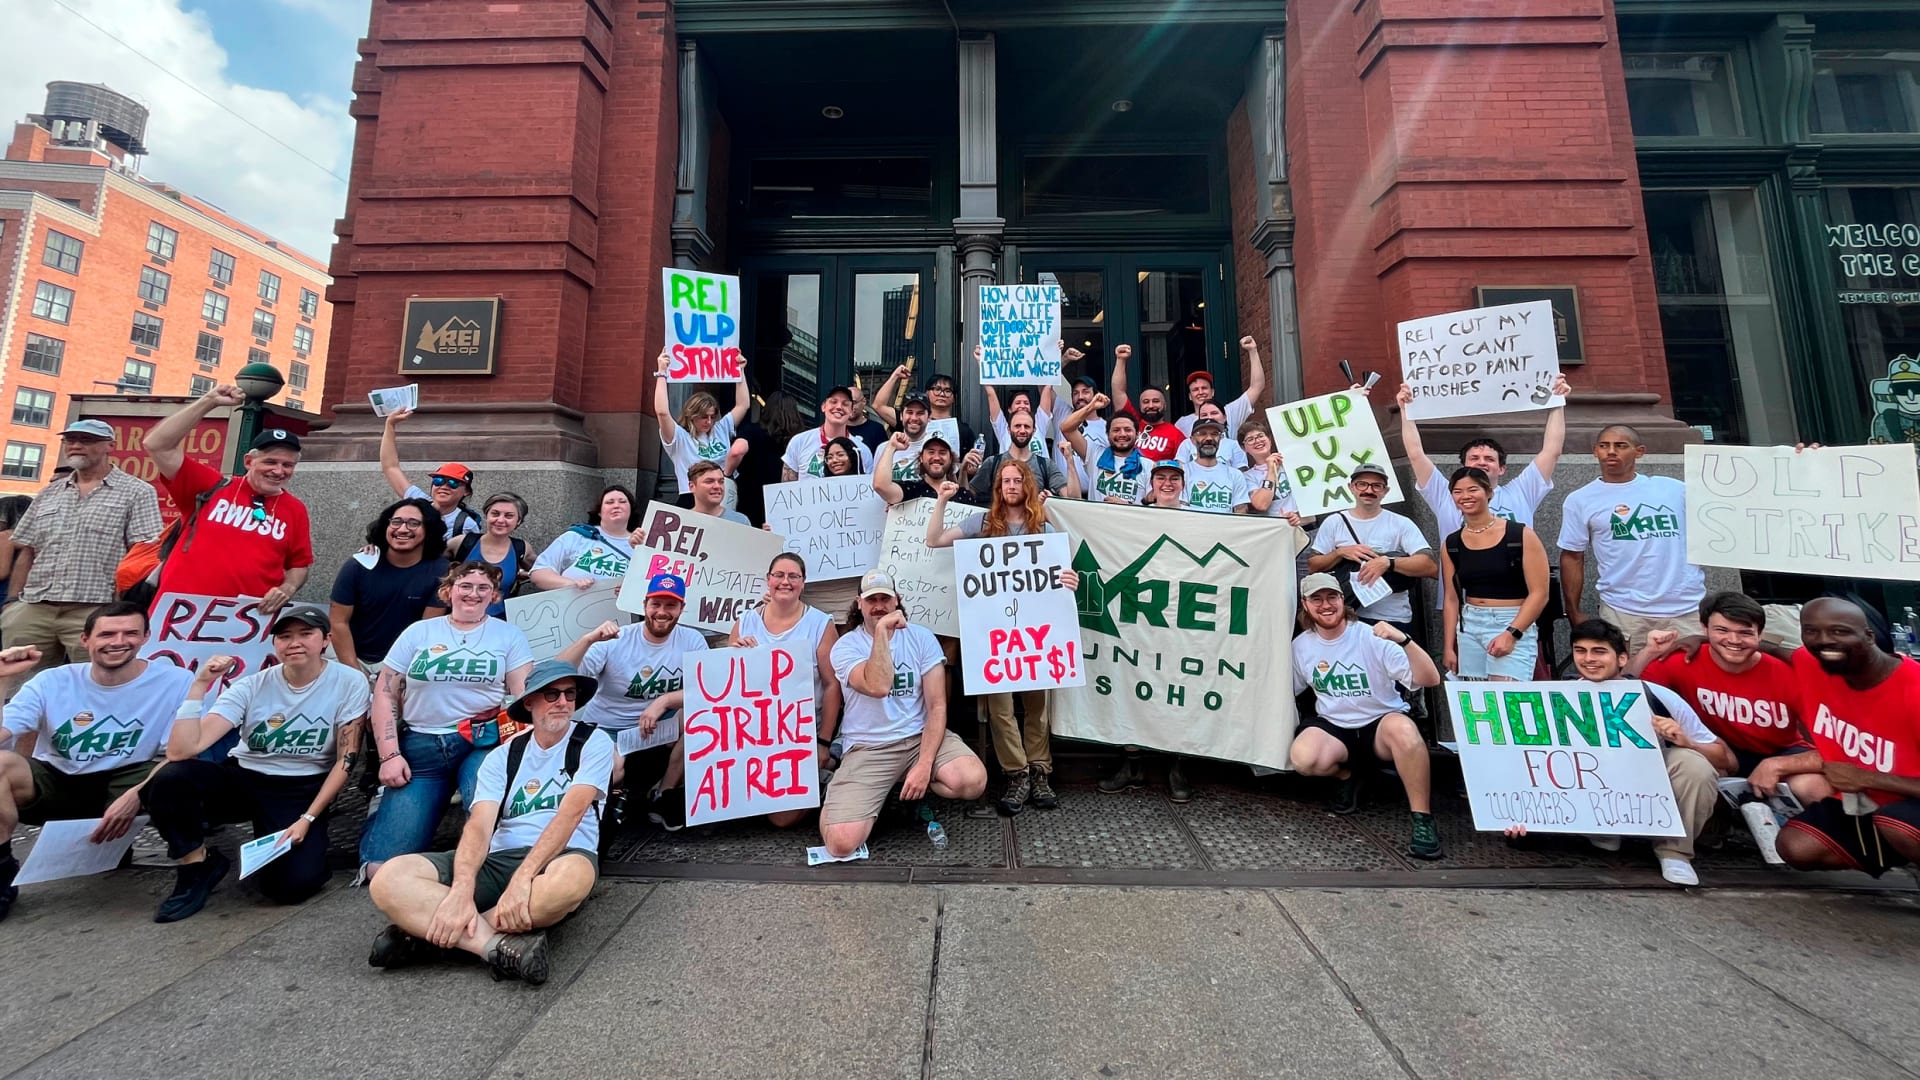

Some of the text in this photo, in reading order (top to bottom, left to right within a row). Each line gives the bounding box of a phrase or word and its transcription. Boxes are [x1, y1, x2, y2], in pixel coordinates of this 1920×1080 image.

[1825, 223, 1920, 247] WELCO
[1839, 253, 1920, 277] THE C
[671, 274, 727, 313] REI
[981, 287, 1009, 303] HOW
[981, 302, 1054, 320] HAVE A LIFE
[438, 329, 481, 347] REI
[674, 312, 735, 346] ULP
[1038, 320, 1052, 335] IF
[1406, 311, 1531, 345] REI CUT MY
[670, 344, 741, 381] STRIKE
[1034, 346, 1044, 360] A
[1408, 334, 1521, 367] PAY CANT
[981, 360, 1025, 379] LIVING
[1406, 355, 1535, 381] AFFORD PAINT
[1412, 379, 1481, 399] BRUSHES
[1282, 394, 1352, 439] ULP
[1312, 435, 1339, 461] U
[1295, 449, 1373, 487] PAY
[1701, 454, 1885, 498] ULP
[769, 482, 876, 515] AN INJURY
[1113, 479, 1138, 496] REI
[1206, 488, 1232, 503] REI
[1322, 486, 1354, 508] M
[207, 498, 287, 541] RWDSU
[783, 506, 860, 535] TO ONE
[1637, 514, 1679, 531] REI
[1696, 501, 1920, 564] STRIKE
[645, 509, 709, 562] REI,
[808, 533, 829, 555] AN
[836, 528, 883, 549] INJUR
[893, 530, 905, 542] I
[1638, 530, 1680, 541] UNION
[596, 560, 628, 574] RE
[818, 551, 868, 573] ALL
[979, 540, 1045, 568] OPT
[963, 565, 1063, 598] OUTSIDE
[699, 597, 764, 624] WAG
[1004, 598, 1018, 627] of
[1119, 577, 1249, 636] REI
[989, 624, 1051, 657] PAY
[435, 658, 498, 676] REI
[697, 649, 795, 702] ULP
[1083, 643, 1246, 681] UNION
[433, 676, 496, 684] UNION
[1095, 675, 1223, 711] SOHO
[1331, 672, 1369, 690] REI
[1333, 690, 1371, 698] UNION
[1458, 691, 1657, 750] HONK
[1697, 688, 1790, 729] RWDSU
[79, 729, 144, 753] REI
[274, 727, 330, 748] REI
[685, 698, 814, 761] STRIKE
[690, 749, 812, 816] AT REI
[1523, 750, 1609, 790] FOR
[1485, 789, 1673, 829] WORKERS RIGHTS
